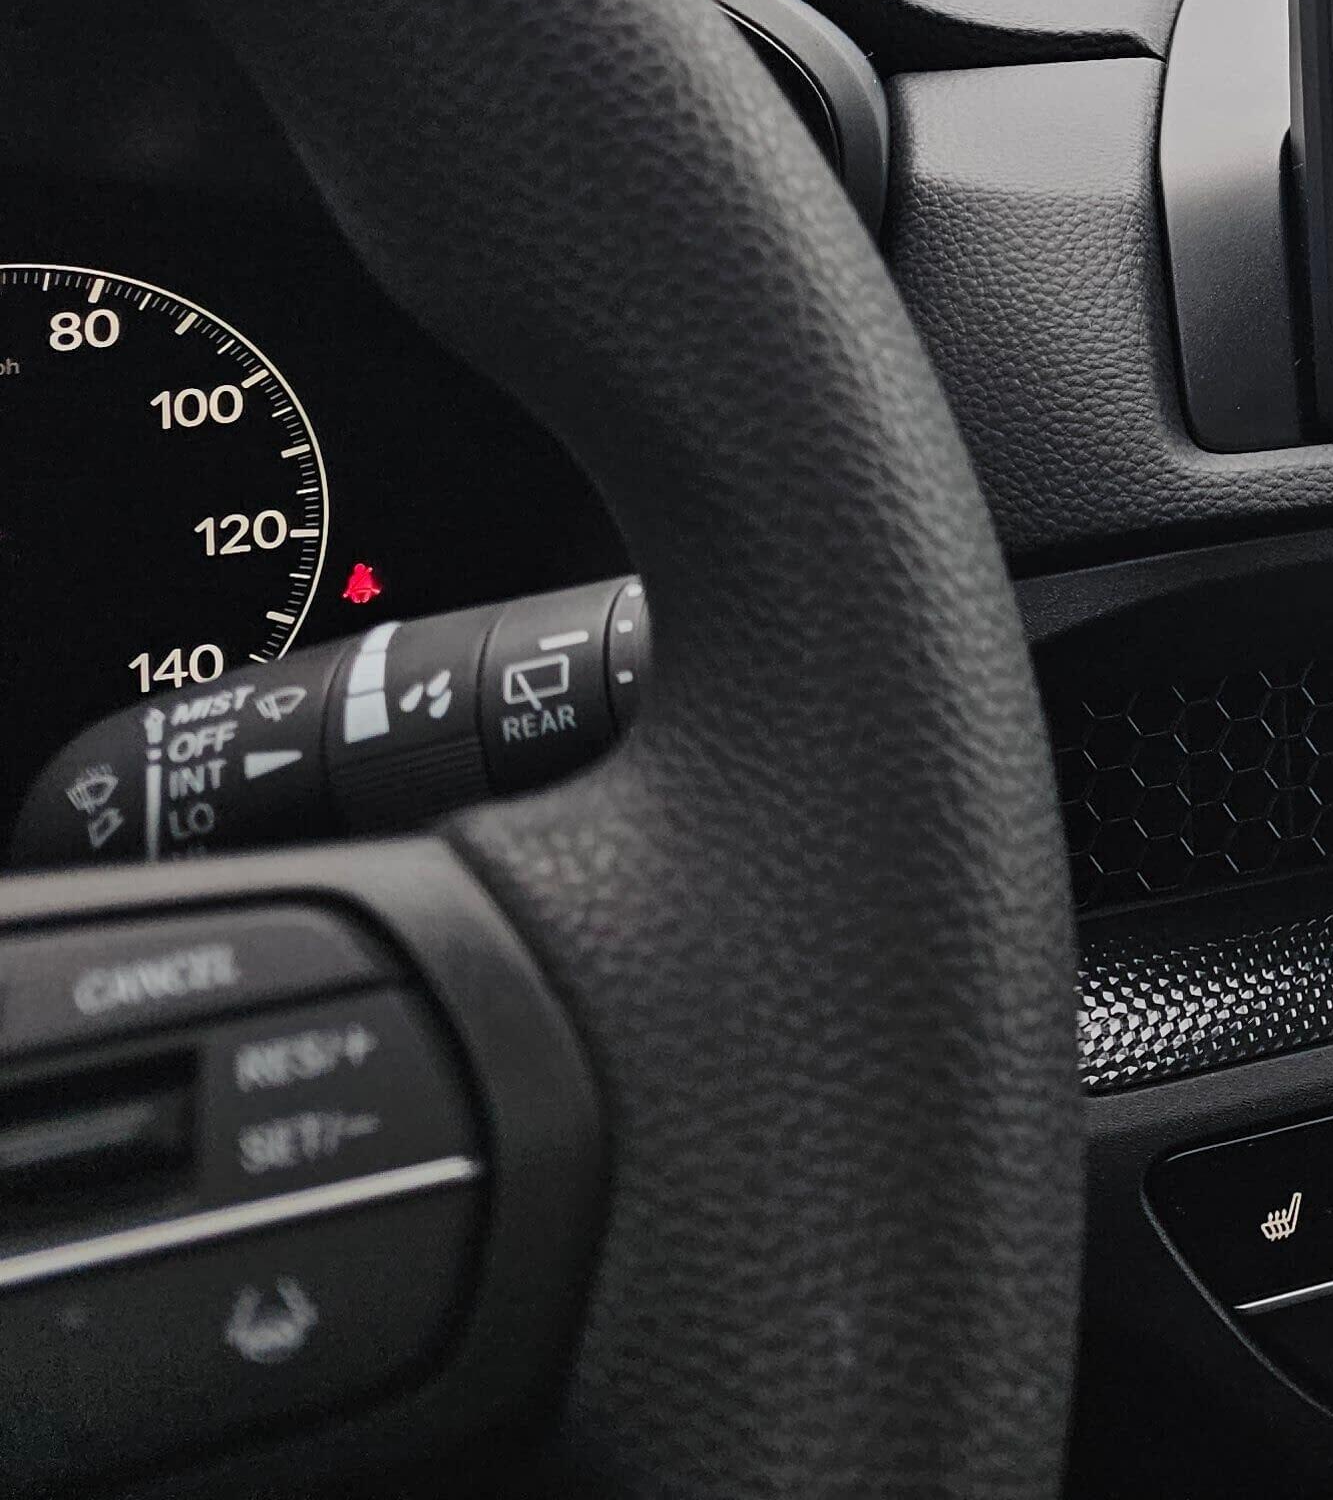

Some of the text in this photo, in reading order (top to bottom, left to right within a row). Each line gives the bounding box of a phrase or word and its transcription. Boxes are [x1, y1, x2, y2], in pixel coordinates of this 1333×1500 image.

[49, 308, 120, 352] 80
[150, 384, 244, 430] 100
[194, 509, 288, 557] 120
[128, 643, 224, 693] 140
[169, 685, 256, 727] MIST
[502, 704, 578, 743] REAR
[167, 719, 238, 763] OFF
[168, 757, 228, 800] INT
[168, 802, 216, 840] LO
